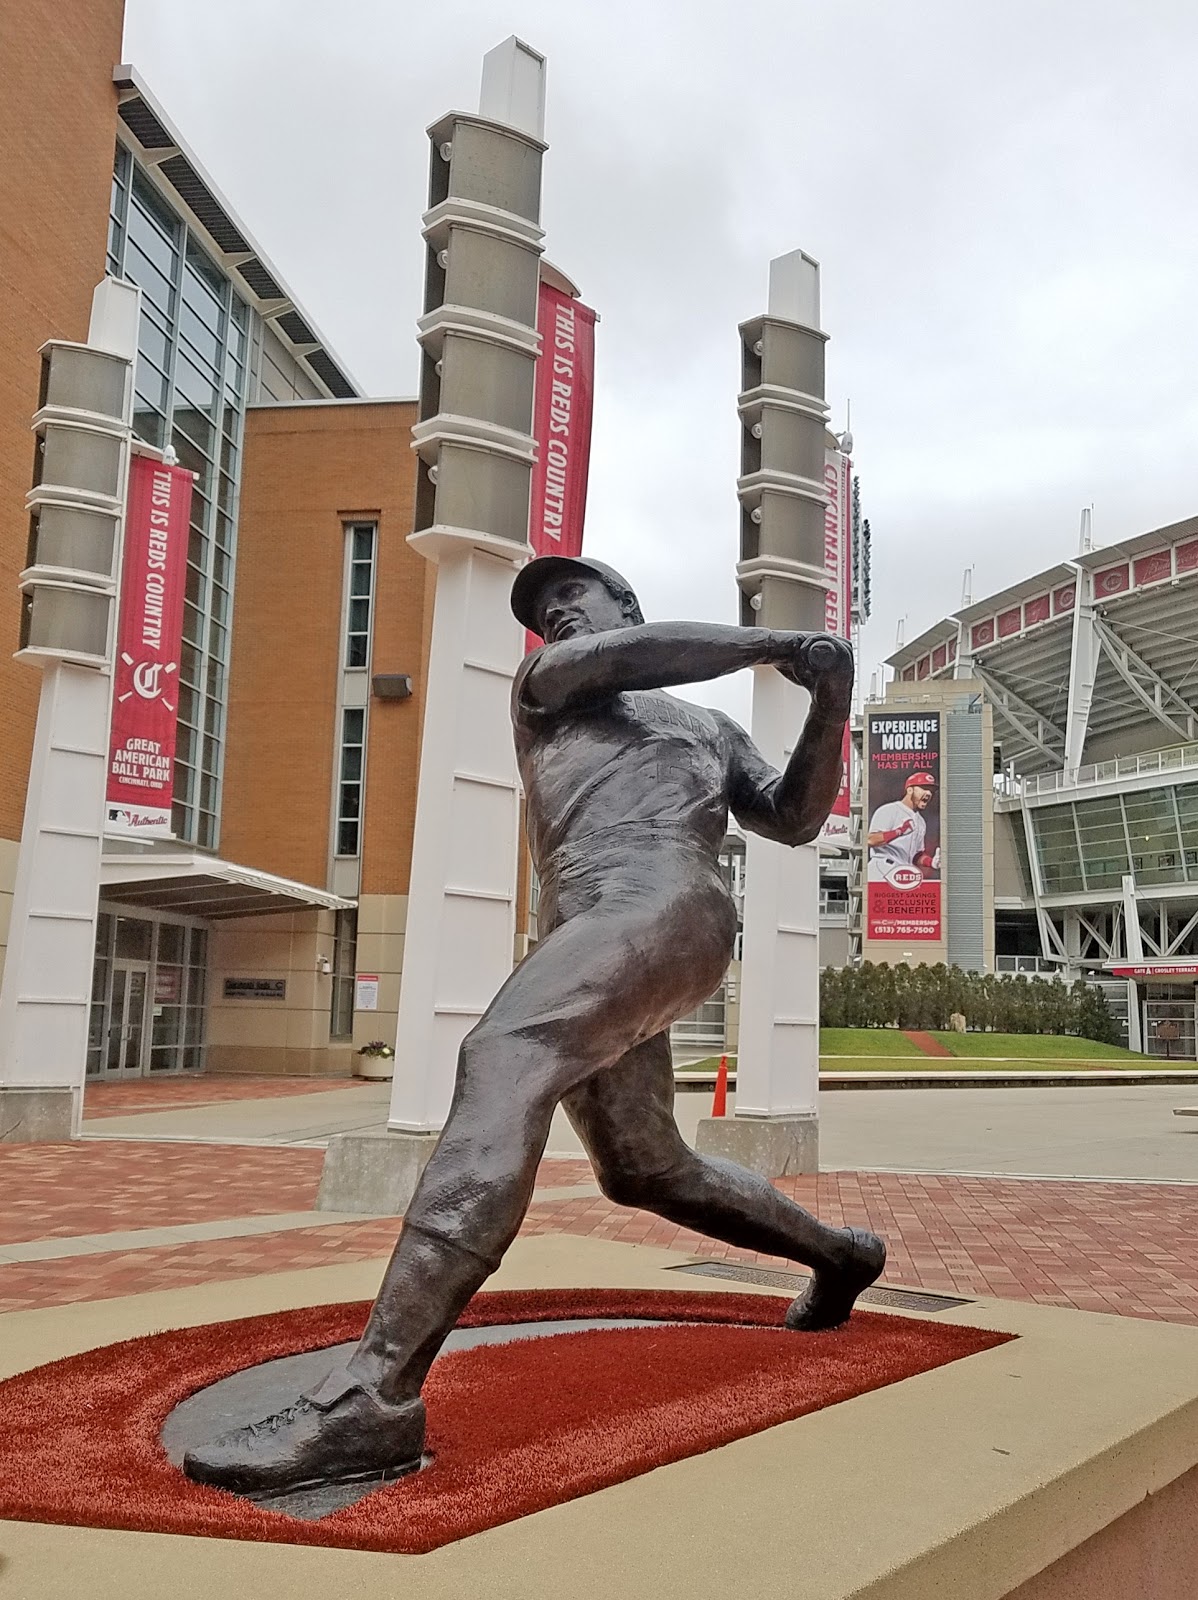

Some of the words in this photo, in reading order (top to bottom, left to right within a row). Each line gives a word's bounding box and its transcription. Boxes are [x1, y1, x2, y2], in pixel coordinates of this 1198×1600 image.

[555, 303, 575, 353] THIS
[553, 352, 574, 378] IS
[549, 379, 572, 436] REDS
[152, 471, 172, 508] THIS
[543, 439, 568, 542] COUNTRY
[151, 509, 169, 527] IS
[147, 528, 168, 571] REDS
[142, 573, 165, 650] COUNTRY
[826, 589, 838, 636] RED
[871, 720, 938, 734] EXPERIENCE
[126, 738, 161, 755] GREAT
[882, 733, 928, 750] MORE!
[114, 749, 170, 769] AMERICAN
[872, 752, 939, 761] MEMBERSHIP
[877, 761, 898, 769] HAS
[111, 761, 139, 777] BALL
[142, 767, 171, 782] PARK
[128, 814, 168, 827] Authentic
[895, 873, 922, 881] REDS
[874, 926, 895, 934] (513)
[896, 926, 935, 934] 765-7500
[1146, 967, 1151, 975] A
